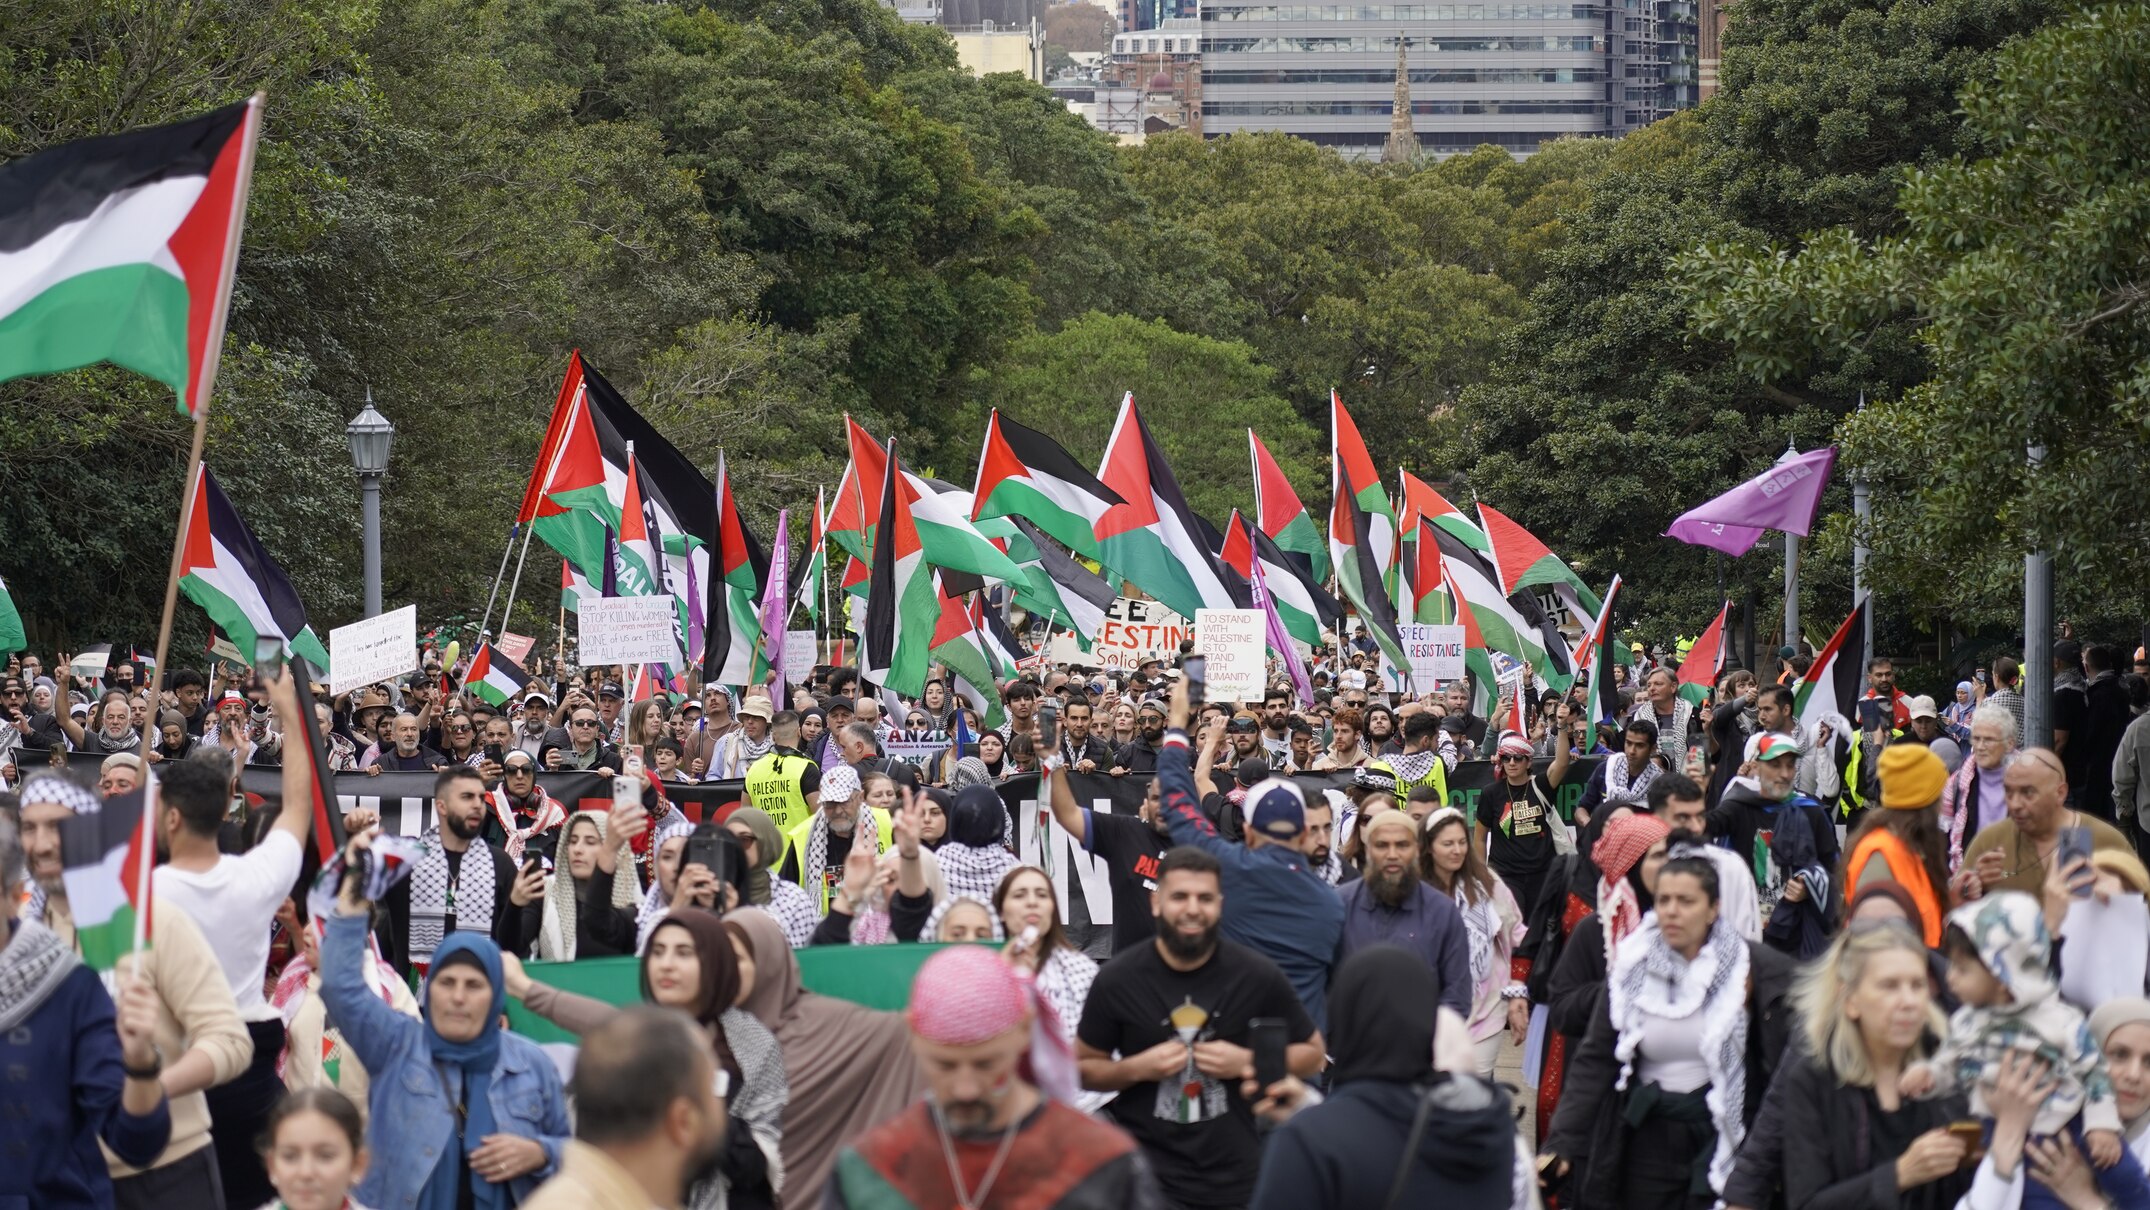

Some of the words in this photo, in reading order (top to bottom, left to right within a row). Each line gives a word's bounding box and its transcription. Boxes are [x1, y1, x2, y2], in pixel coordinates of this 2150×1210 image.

[580, 600, 596, 611] from
[635, 600, 643, 609] to
[581, 612, 606, 624] STOP
[609, 611, 640, 622] KILLING
[1203, 615, 1217, 623] TO
[1219, 615, 1251, 624] STAND
[581, 634, 607, 647] NONE
[610, 633, 618, 644] of
[620, 635, 630, 643] us
[647, 629, 668, 643] FREE
[1203, 634, 1253, 642] PALESTINE
[581, 647, 599, 658] until
[601, 647, 616, 661] ALL
[618, 646, 626, 659] of
[651, 644, 673, 659] FREE
[1203, 644, 1211, 652] IS
[1214, 644, 1227, 652] TO
[1410, 643, 1462, 658] RESISTANCE
[1204, 653, 1235, 661] STAND
[1203, 663, 1227, 671] WITH
[335, 676, 361, 691] DEMAND
[368, 666, 398, 681] CEASEFIRE
[1203, 673, 1251, 681] HUMANITY
[753, 780, 790, 795] PALESTINE
[1514, 802, 1527, 811] FREE
